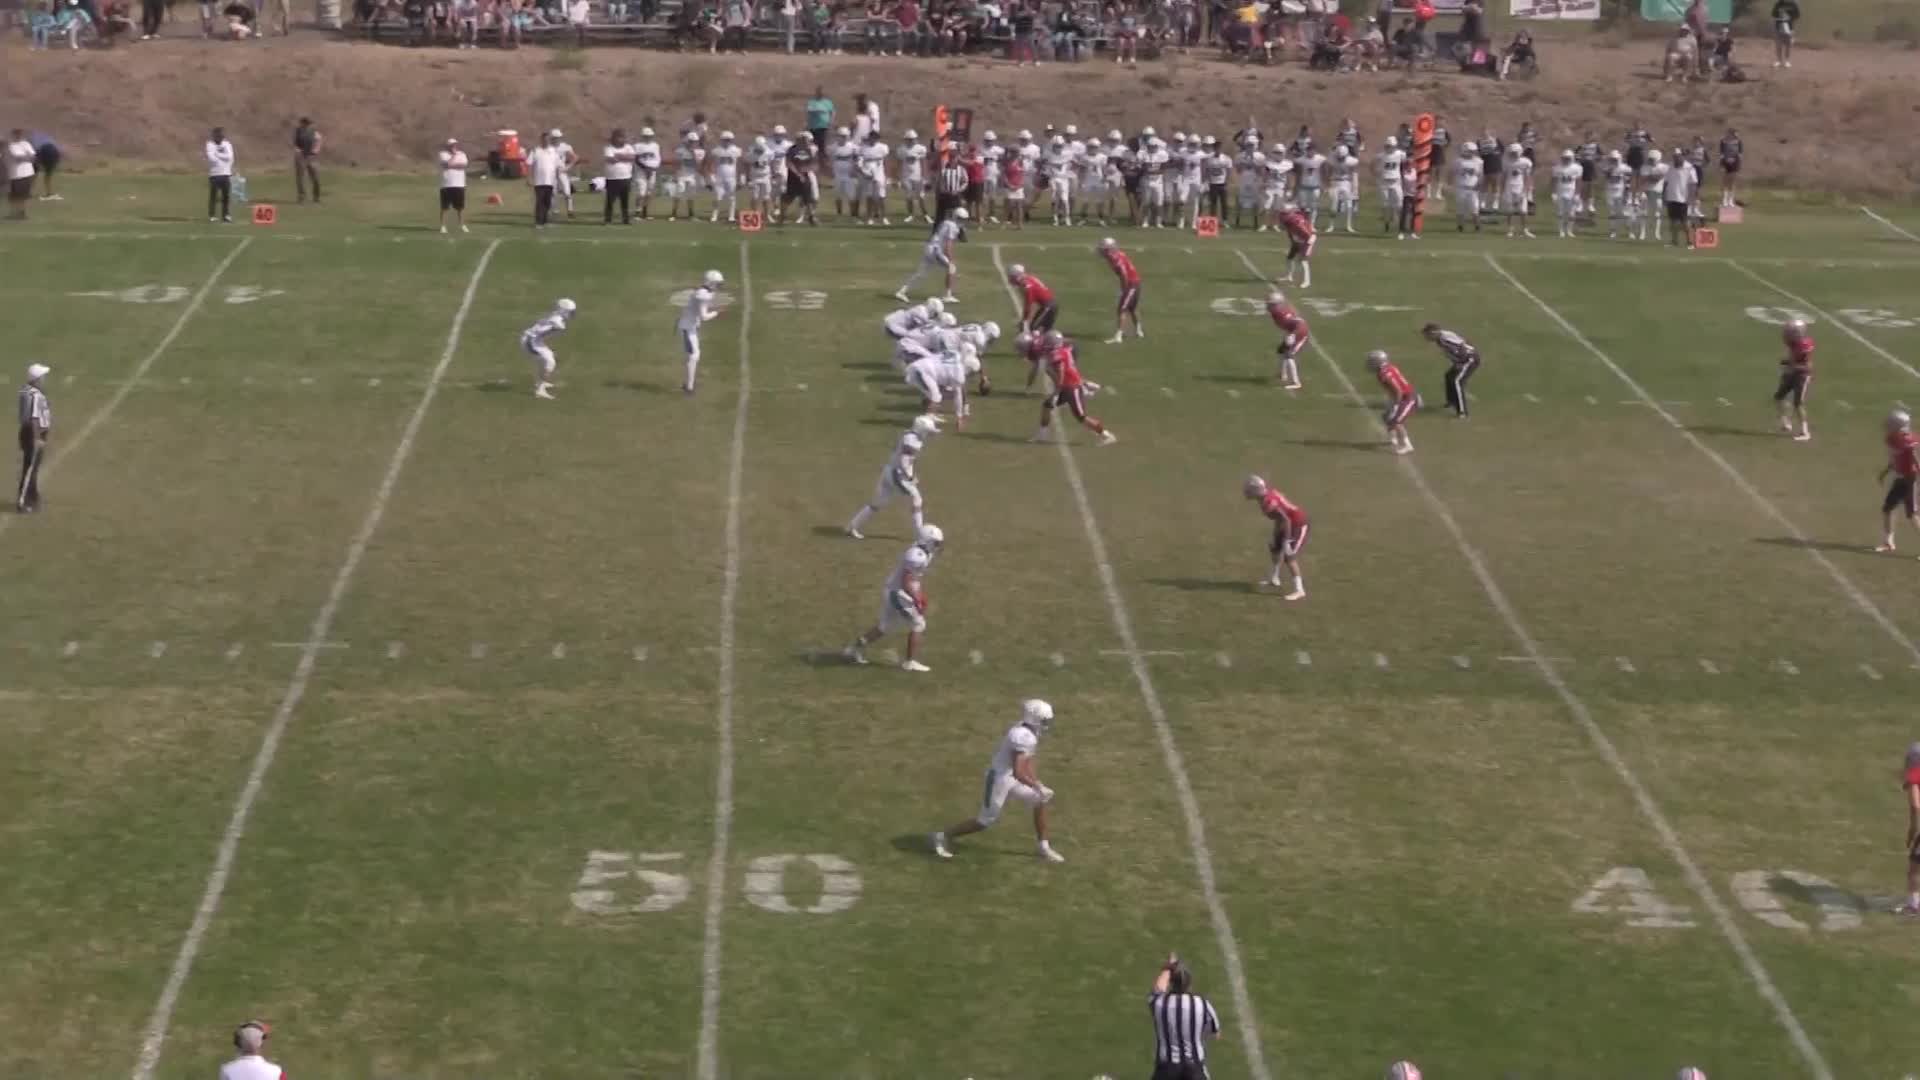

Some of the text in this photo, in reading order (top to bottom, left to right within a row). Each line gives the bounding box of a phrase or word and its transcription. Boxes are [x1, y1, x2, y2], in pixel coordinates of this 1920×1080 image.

[255, 207, 273, 222] 40
[742, 213, 760, 228] 50
[569, 850, 863, 914] 50
[1571, 867, 1863, 931] 40
